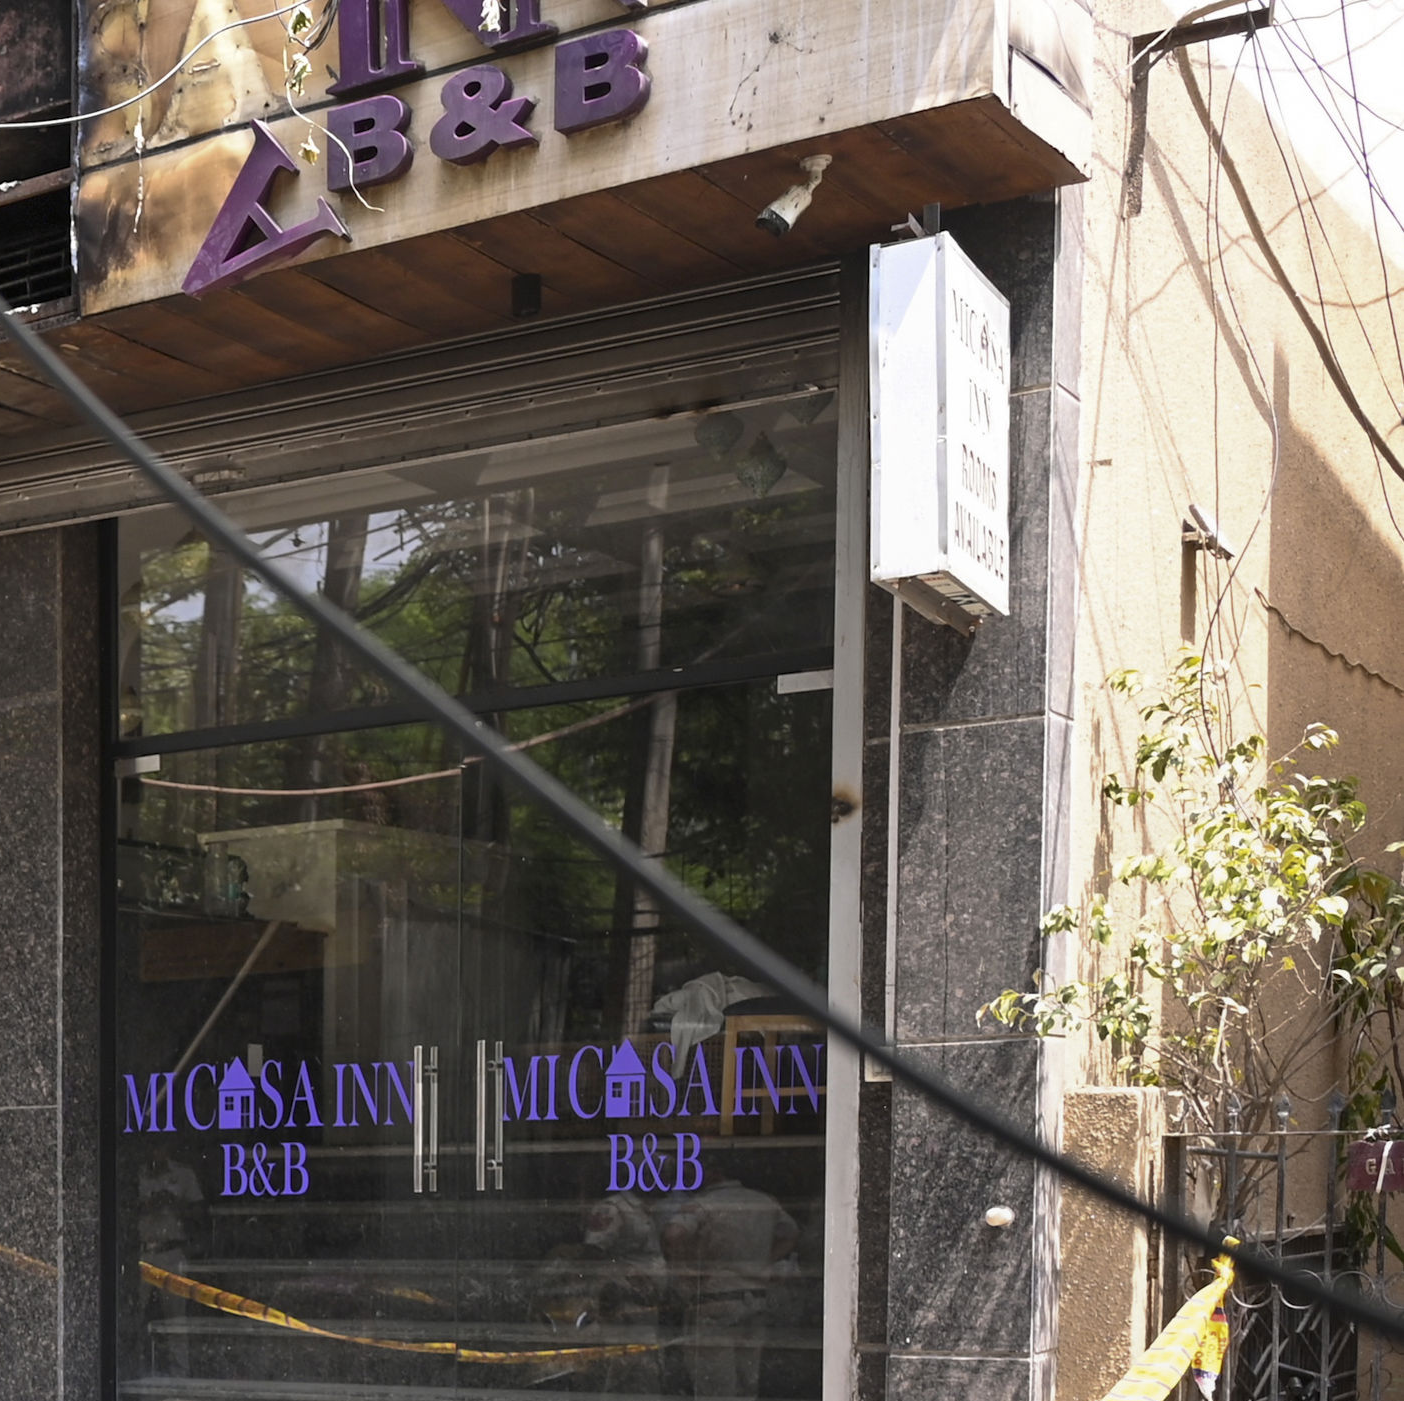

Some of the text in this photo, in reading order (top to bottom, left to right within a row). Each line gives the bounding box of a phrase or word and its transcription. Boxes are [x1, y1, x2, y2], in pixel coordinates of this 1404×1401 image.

[327, 28, 652, 193] B&B
[962, 442, 997, 512] ROOMS
[954, 500, 1005, 581] AVAILABLE
[122, 1071, 178, 1134] MI
[331, 1060, 415, 1127] INN
[502, 1055, 560, 1121] MI
[731, 1043, 825, 1117] INN
[219, 1142, 310, 1197] B&B
[606, 1132, 704, 1192] B&B
